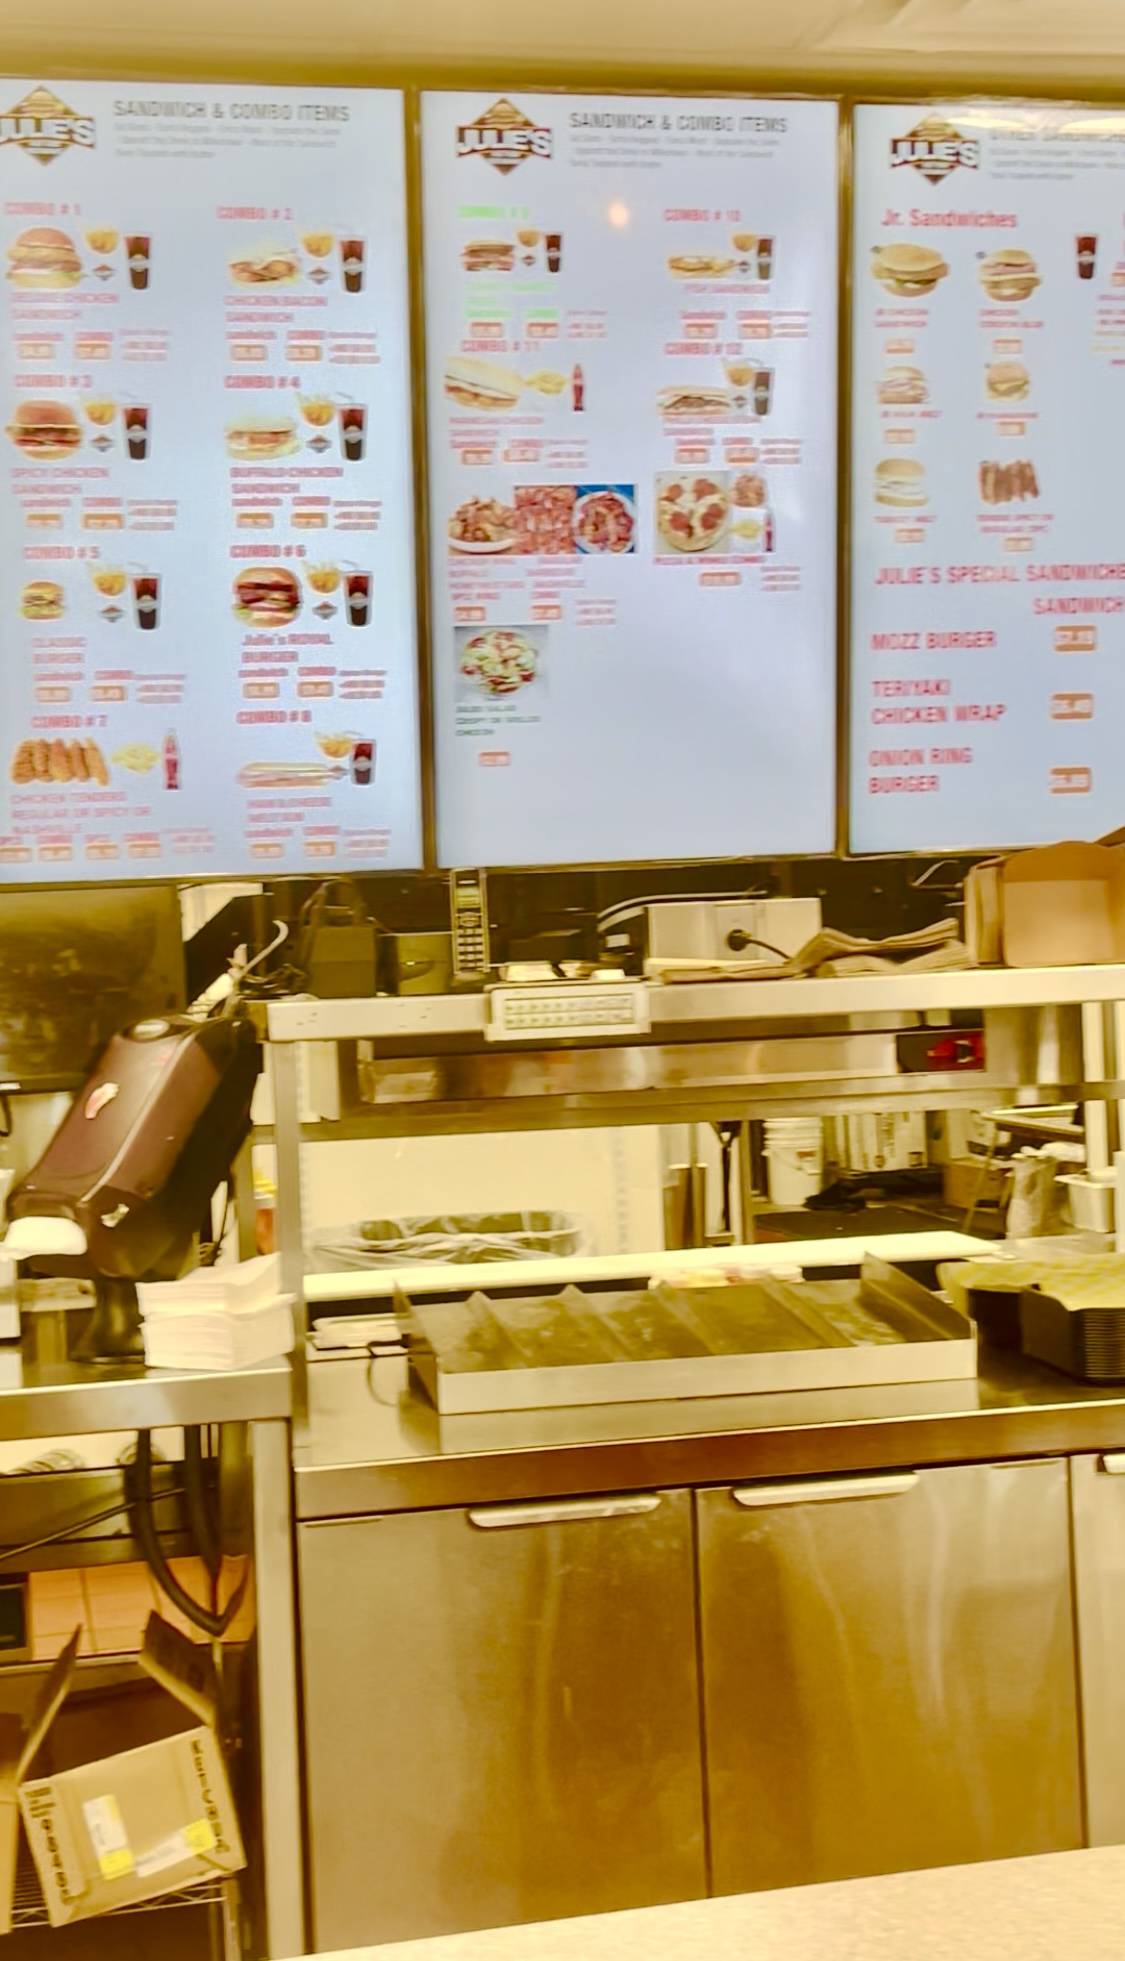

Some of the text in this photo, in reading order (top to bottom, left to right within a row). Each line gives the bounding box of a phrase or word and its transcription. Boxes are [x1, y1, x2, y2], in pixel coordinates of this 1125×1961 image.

[112, 100, 350, 121] SANDWICH & COMBO ITEMS
[569, 112, 788, 132] SANDWICH & COMBO ITEMS
[882, 209, 1018, 228] Jr. Sandwiches
[875, 567, 942, 585] JULIE'S
[946, 565, 1020, 583] SPECIAL
[872, 631, 996, 650] MOZZ BURGER
[872, 679, 951, 697] TERIYAKI
[872, 704, 1006, 724] CHICKEN WRAP
[869, 747, 972, 767] ONION RING
[869, 775, 939, 794] BURGER
